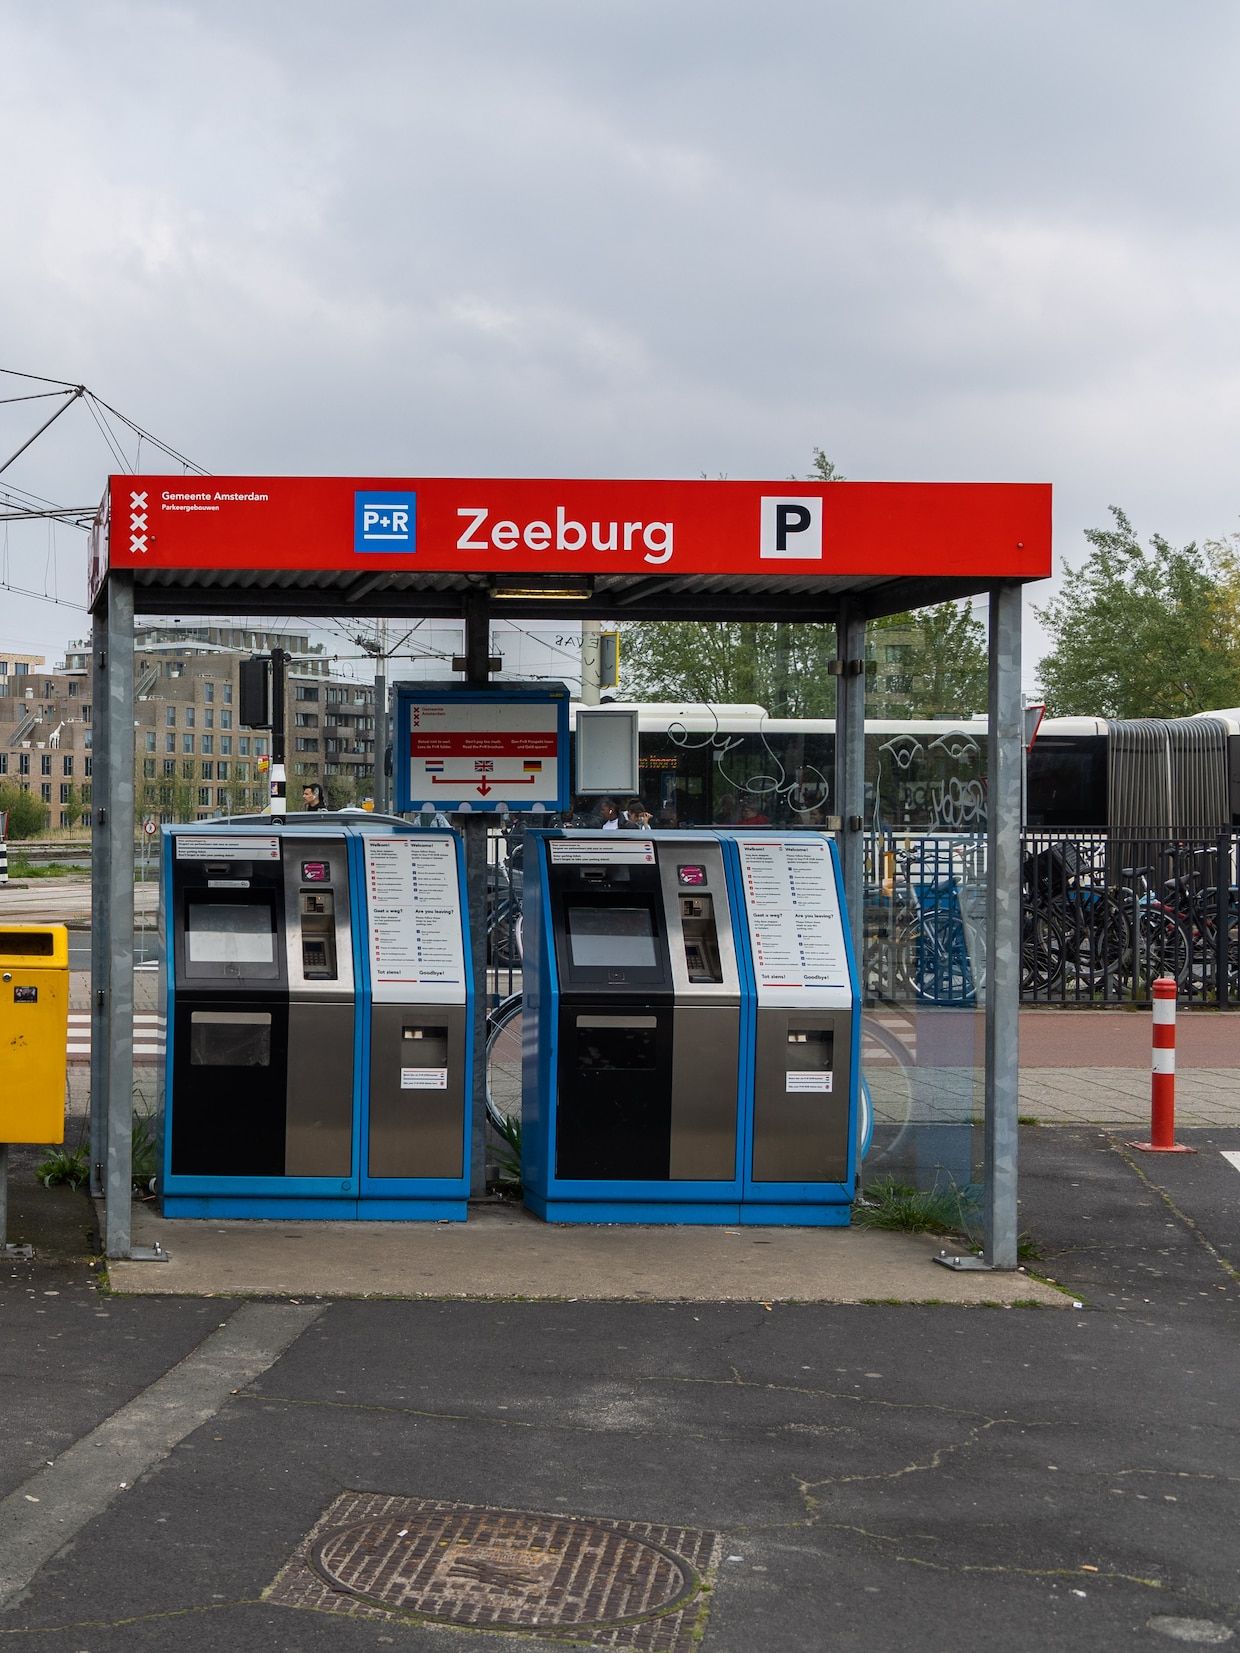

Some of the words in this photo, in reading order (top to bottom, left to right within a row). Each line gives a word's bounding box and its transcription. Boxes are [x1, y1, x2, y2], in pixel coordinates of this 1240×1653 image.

[162, 492, 211, 500] Gemeente
[214, 492, 268, 501] Amsterdam
[162, 504, 220, 512] Parkeergebouwen
[364, 511, 408, 532] P+R
[776, 504, 811, 551] P
[456, 506, 674, 564] Zeeburg
